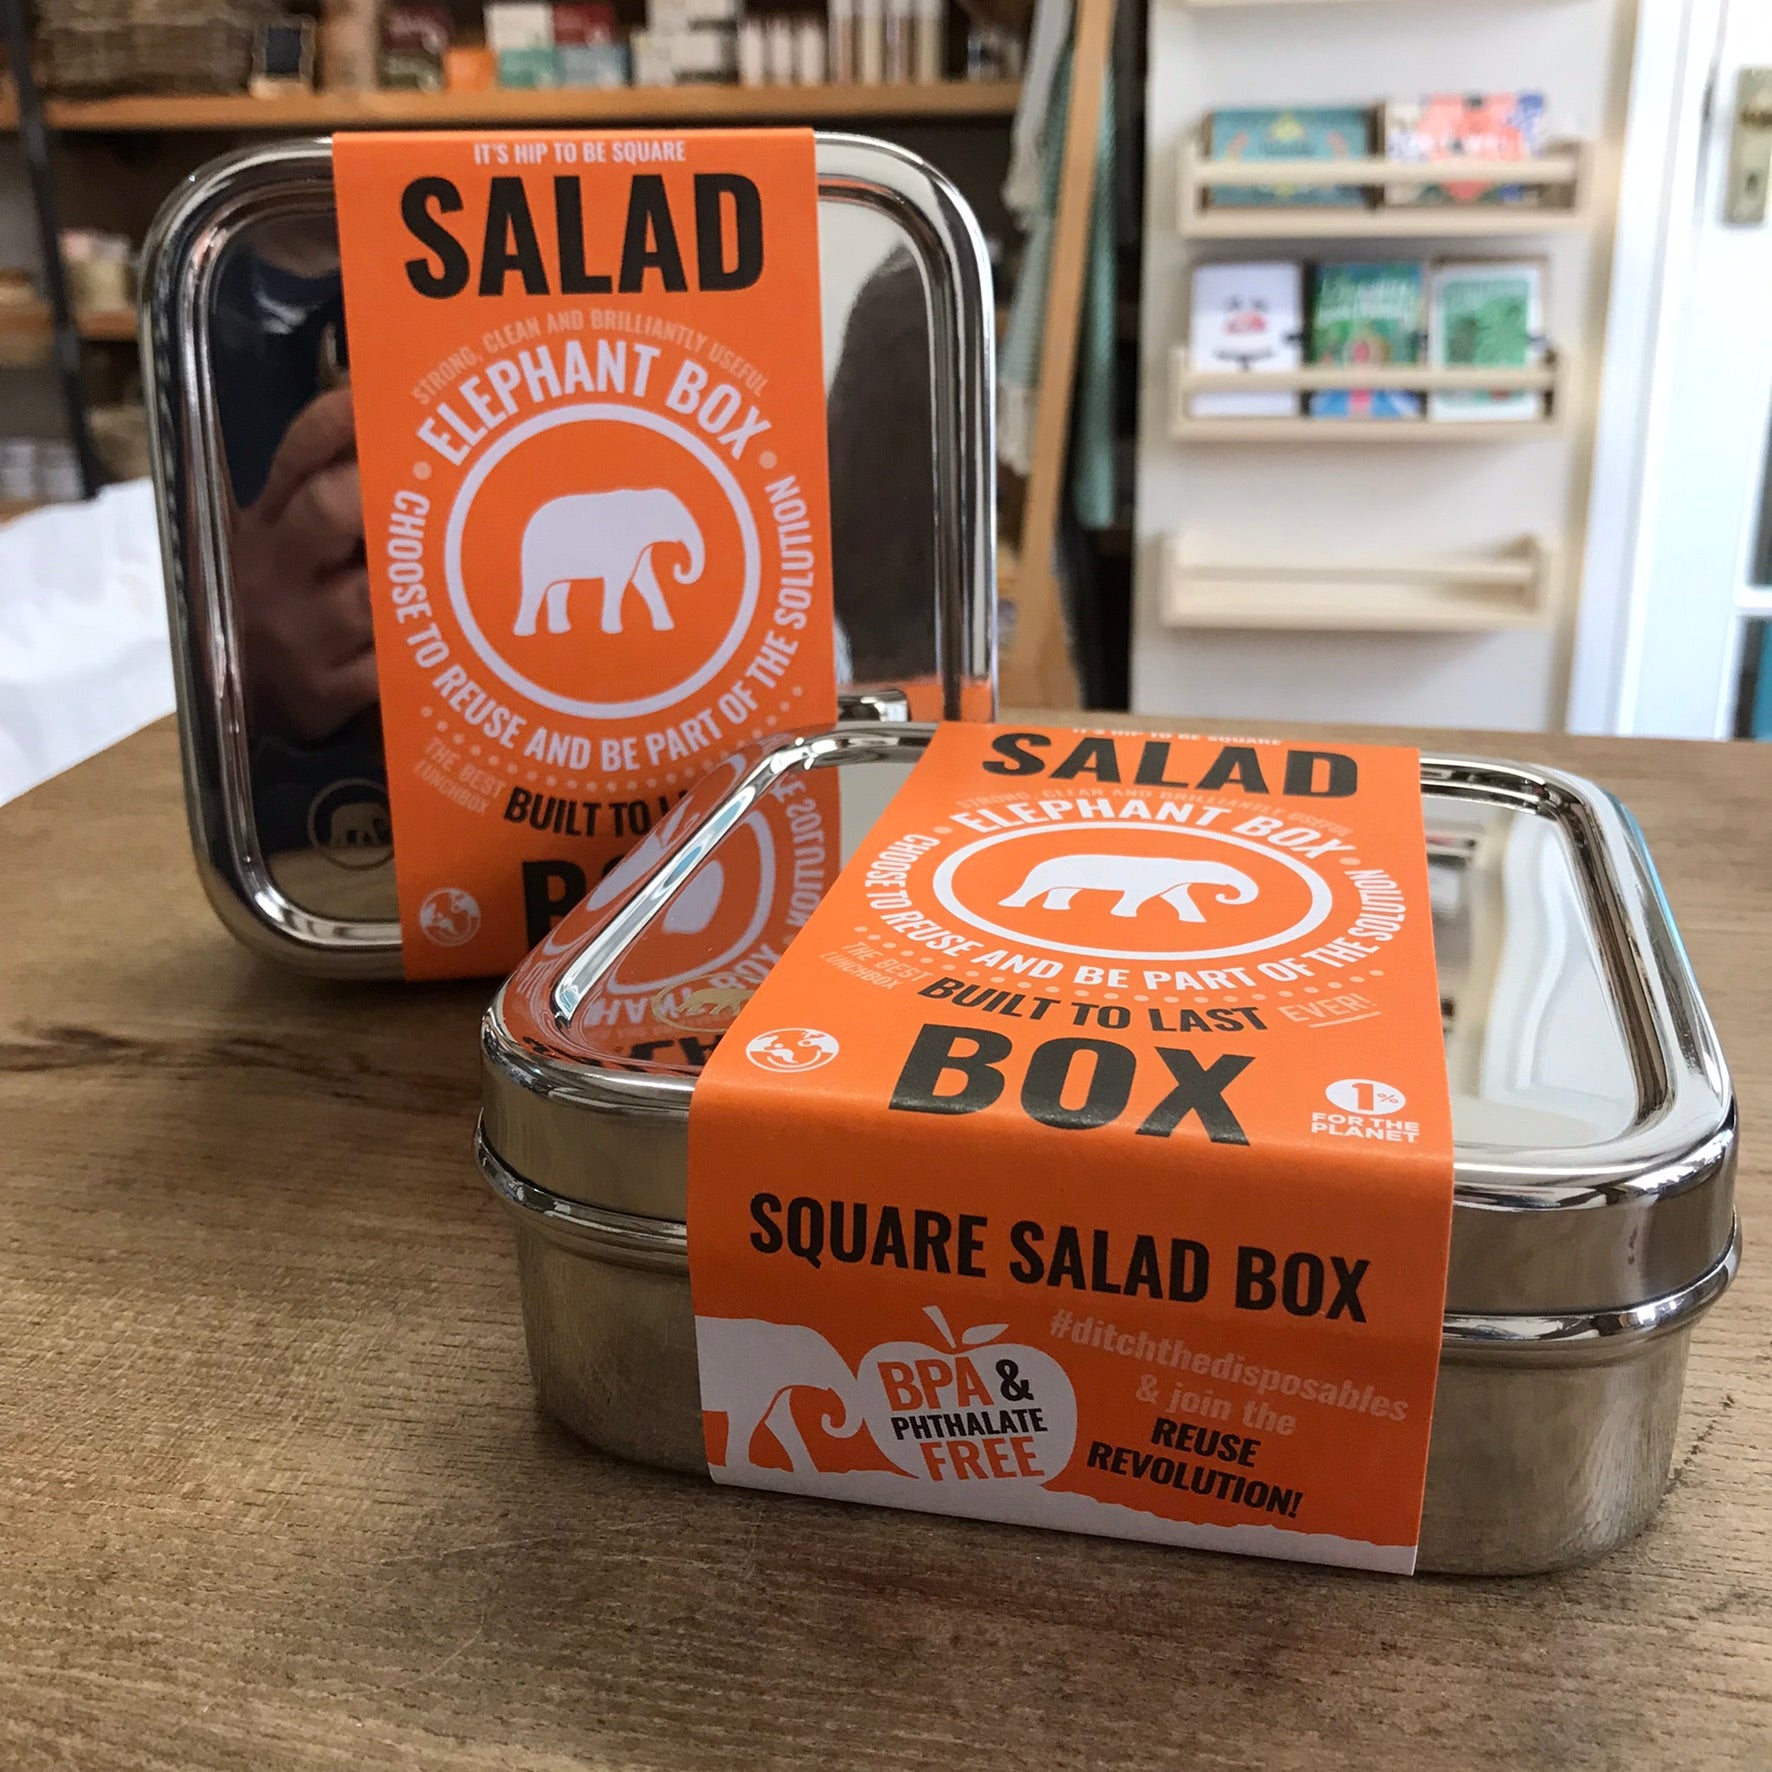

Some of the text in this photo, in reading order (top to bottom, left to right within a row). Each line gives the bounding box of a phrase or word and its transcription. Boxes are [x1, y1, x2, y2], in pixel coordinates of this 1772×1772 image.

[474, 140, 685, 164] IT'S HIP TO BE SQUARE
[401, 173, 764, 300] SALAD
[483, 318, 541, 355] CLEAN
[547, 310, 584, 334] AND
[590, 308, 706, 354] BRILLIANTLY
[708, 343, 768, 397] USEFUL
[417, 339, 772, 466] ELEPHANT BOX
[388, 475, 814, 772] CHOOSE TO REUSE AND BE PART OF THE SOLUTION
[459, 763, 507, 799] BEST
[982, 732, 1358, 799] SALAD
[503, 786, 602, 837] BUILT
[608, 800, 650, 837] TO
[951, 797, 1356, 859] ELEPHANT BOX
[865, 834, 1407, 991] CHOOSE TO REUSE AND BE PART OF THE SOLUTION
[818, 951, 904, 990] LUNCHBOX
[842, 941, 934, 982] THE BEST
[917, 976, 1268, 1033] BUILT TO LAST
[1277, 993, 1378, 1022] EVER!
[888, 1023, 1255, 1147] BOX
[1311, 1122, 1420, 1143] PLANET
[1312, 1112, 1420, 1132] FOR THE
[749, 1192, 1370, 1323] SQUARE SALAD BOX
[878, 1358, 1034, 1411] BPA &
[1050, 1309, 1409, 1423] #ditchthedisposables
[890, 1407, 1049, 1441] PHTHALATE
[1135, 1374, 1297, 1437] & join the
[917, 1436, 1046, 1482] FREE
[1151, 1417, 1262, 1468] REUSE
[1086, 1440, 1304, 1519] REVOLUTION!
